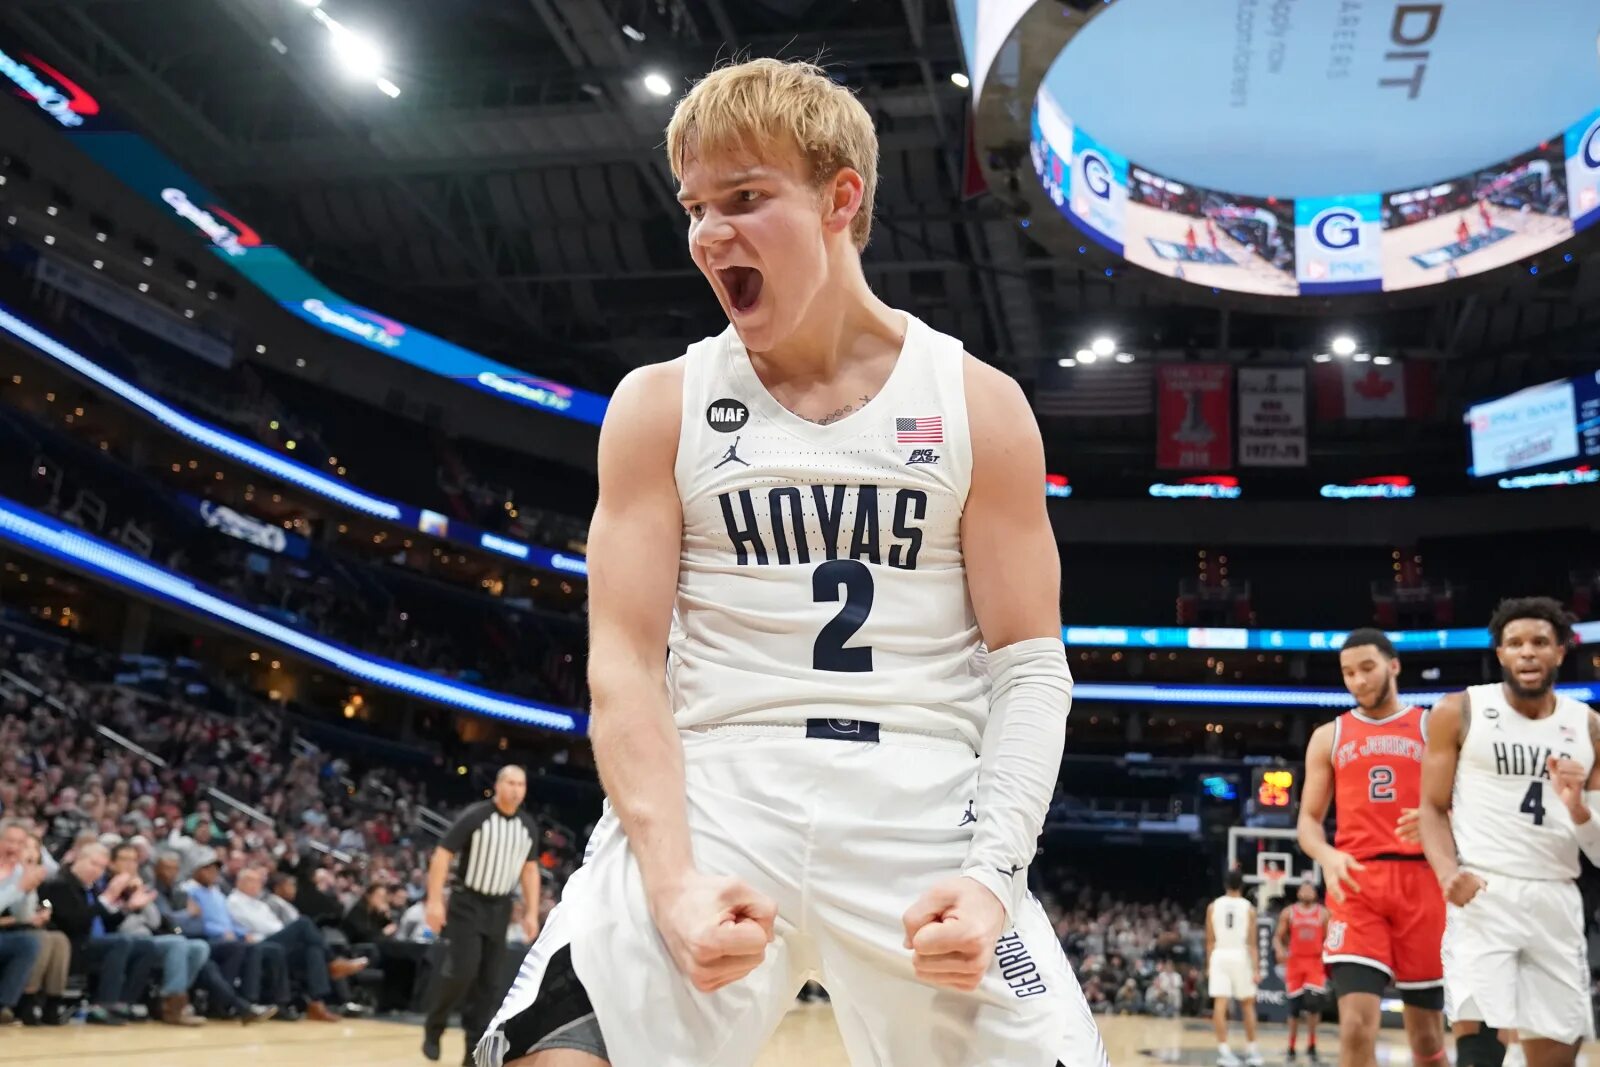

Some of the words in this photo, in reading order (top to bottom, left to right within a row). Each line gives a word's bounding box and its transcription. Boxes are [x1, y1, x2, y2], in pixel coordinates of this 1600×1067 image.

[1316, 212, 1360, 249] G
[710, 406, 745, 423] MAF
[908, 455, 941, 463] EAST
[719, 484, 928, 570] HOYAS
[812, 559, 875, 672] 2
[1493, 742, 1571, 780] HOYA
[1368, 765, 1397, 803] 2
[1519, 780, 1546, 826] 4
